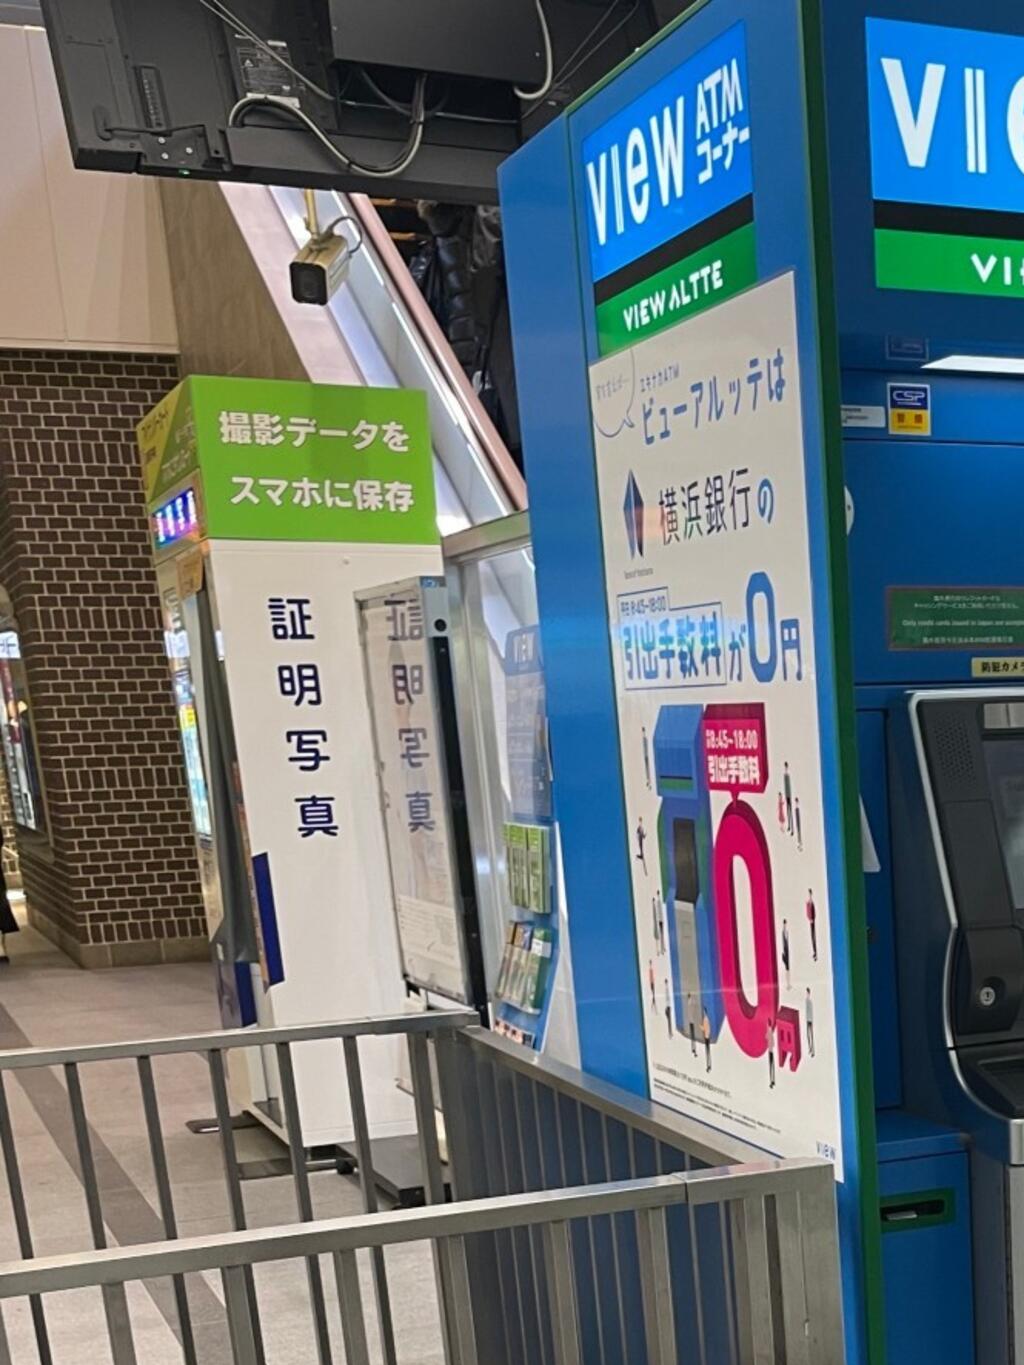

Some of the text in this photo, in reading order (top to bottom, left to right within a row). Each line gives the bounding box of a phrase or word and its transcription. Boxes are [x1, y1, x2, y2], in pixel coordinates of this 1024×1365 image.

[695, 57, 744, 139] ATM
[695, 120, 750, 185] コーナー
[622, 259, 724, 332] VIEW ALTTE
[219, 410, 410, 452] 撮影データを
[642, 348, 786, 445] ビューアルッテは
[892, 390, 926, 404] CSP
[230, 476, 415, 513] スマホに保存
[658, 468, 774, 546] 横浜銀行の
[267, 596, 340, 838] 証明写真
[714, 799, 801, 1073] 0円
